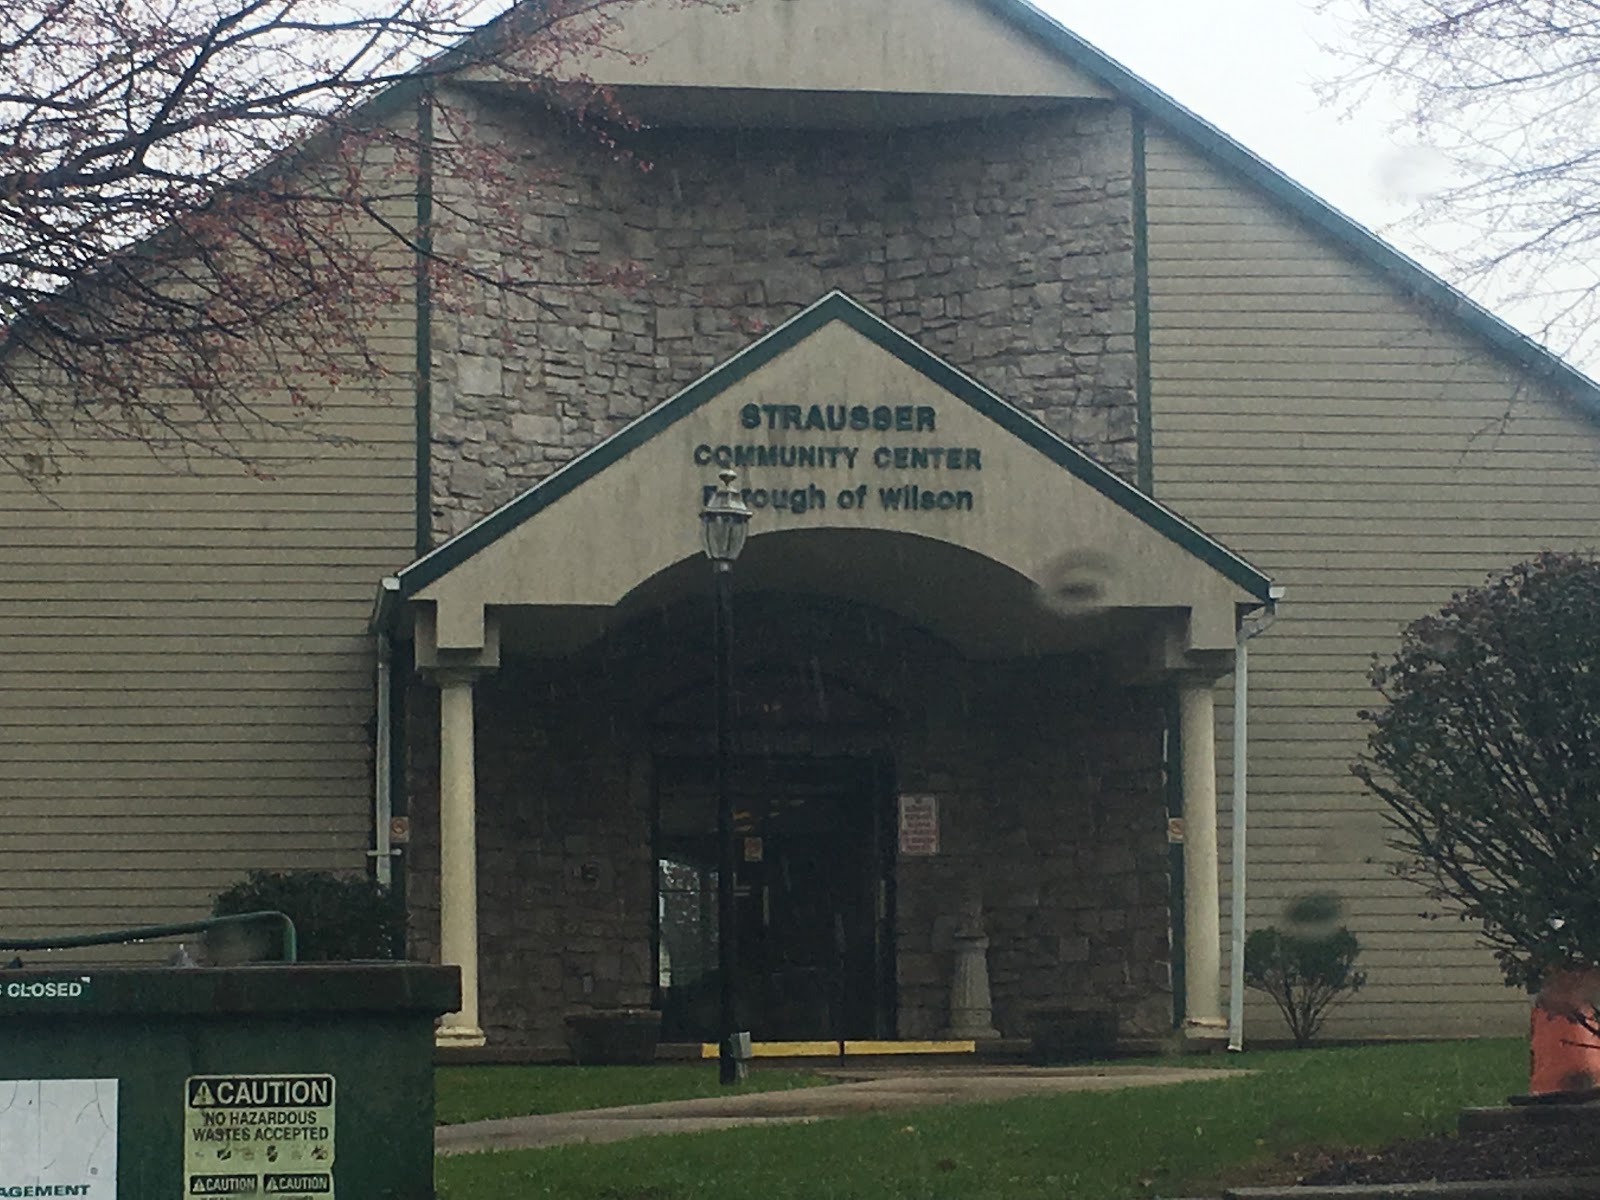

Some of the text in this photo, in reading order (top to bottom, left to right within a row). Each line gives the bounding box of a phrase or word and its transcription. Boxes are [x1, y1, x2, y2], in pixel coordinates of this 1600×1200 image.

[740, 402, 936, 432] STRAUSSER
[694, 444, 982, 470] COMMUNITY CENTER
[837, 484, 868, 510] of
[878, 485, 974, 511] Wilson
[7, 982, 82, 998] CLOSED
[217, 1081, 329, 1104] CAUTION
[204, 1111, 317, 1126] NO HAZARDOUS
[193, 1127, 329, 1141] WASTES ACCEPTED
[206, 1178, 256, 1191] CAUTION
[278, 1177, 328, 1190] CAUTION
